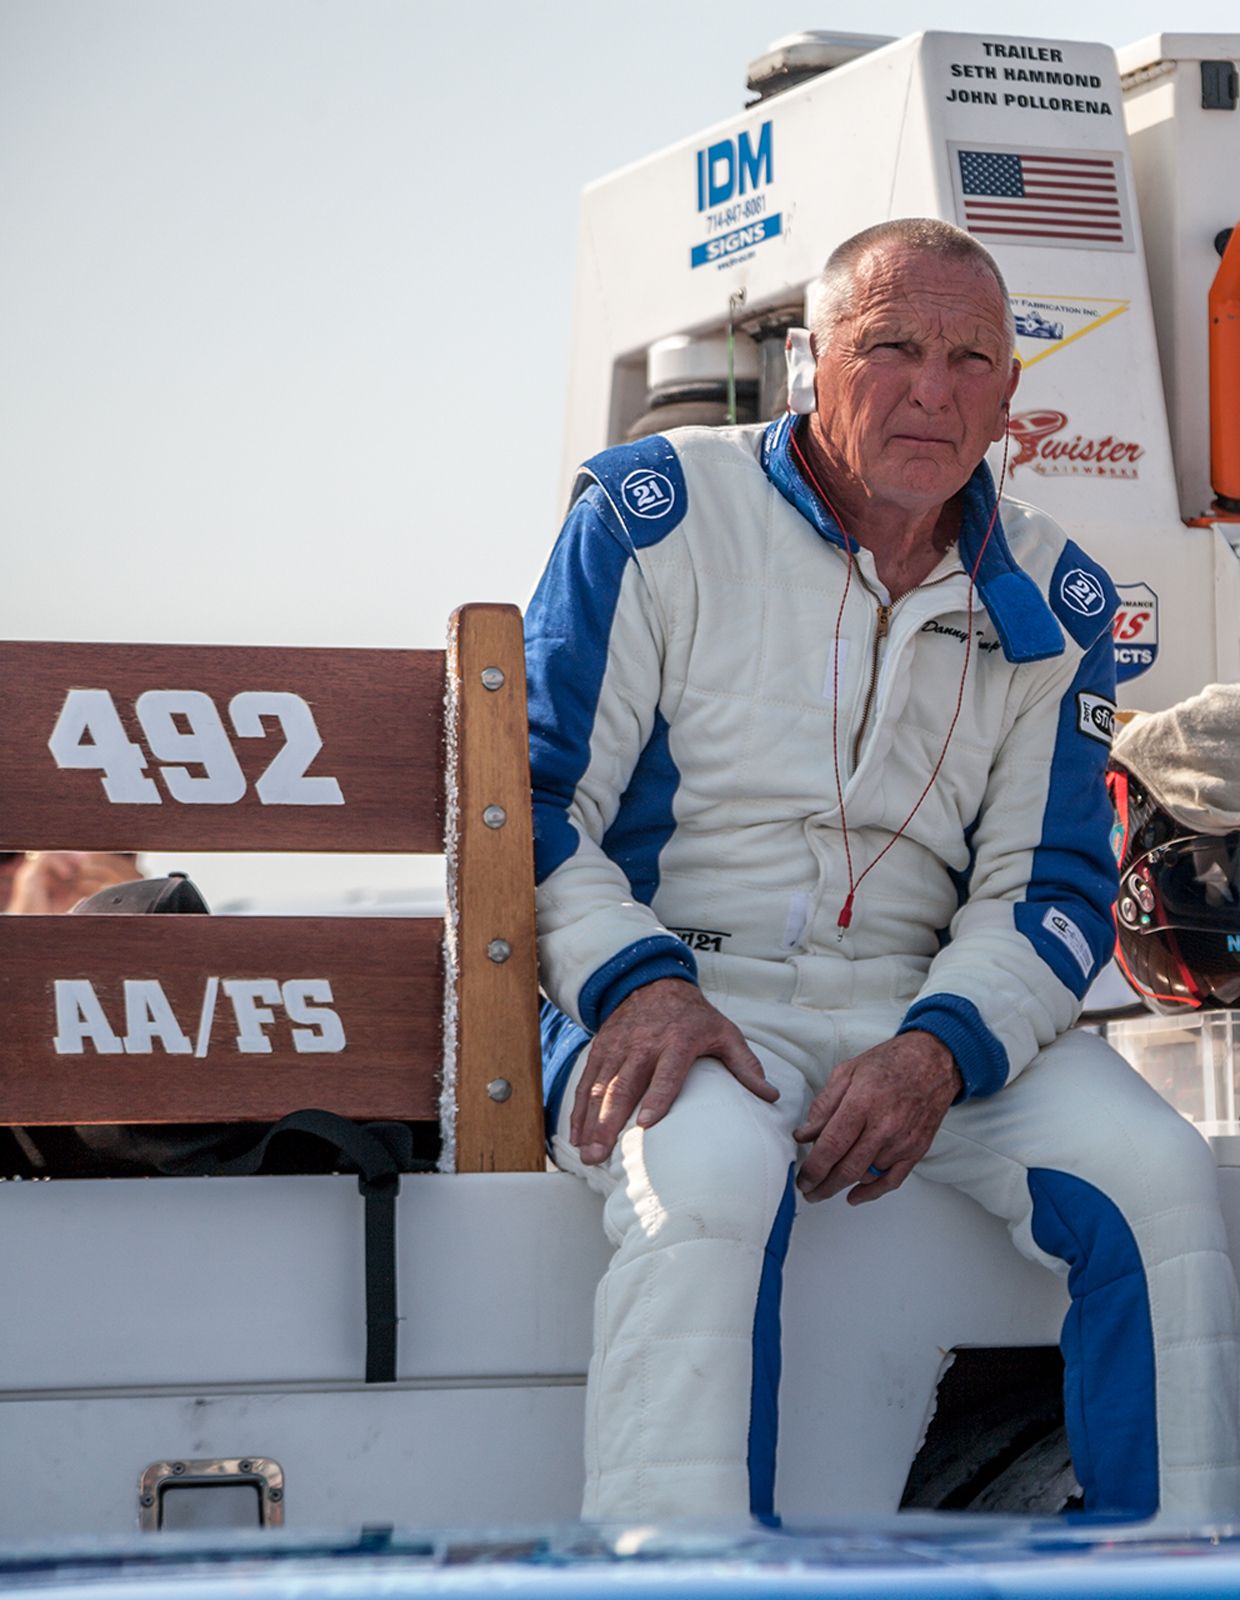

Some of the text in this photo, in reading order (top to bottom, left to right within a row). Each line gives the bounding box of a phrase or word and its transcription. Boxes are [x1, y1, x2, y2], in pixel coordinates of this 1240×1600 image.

[982, 42, 1064, 63] TRAILER
[950, 63, 1102, 89] SETH HAMMOND
[945, 88, 1113, 116] JOHN POLLORENA
[696, 120, 774, 213] IDM
[706, 222, 766, 259] SIGNS
[1021, 300, 1081, 315] FABRICATION
[632, 480, 664, 507] 21
[1068, 578, 1098, 606] 21
[47, 688, 346, 805] 492
[53, 976, 347, 1058] AA/FS
